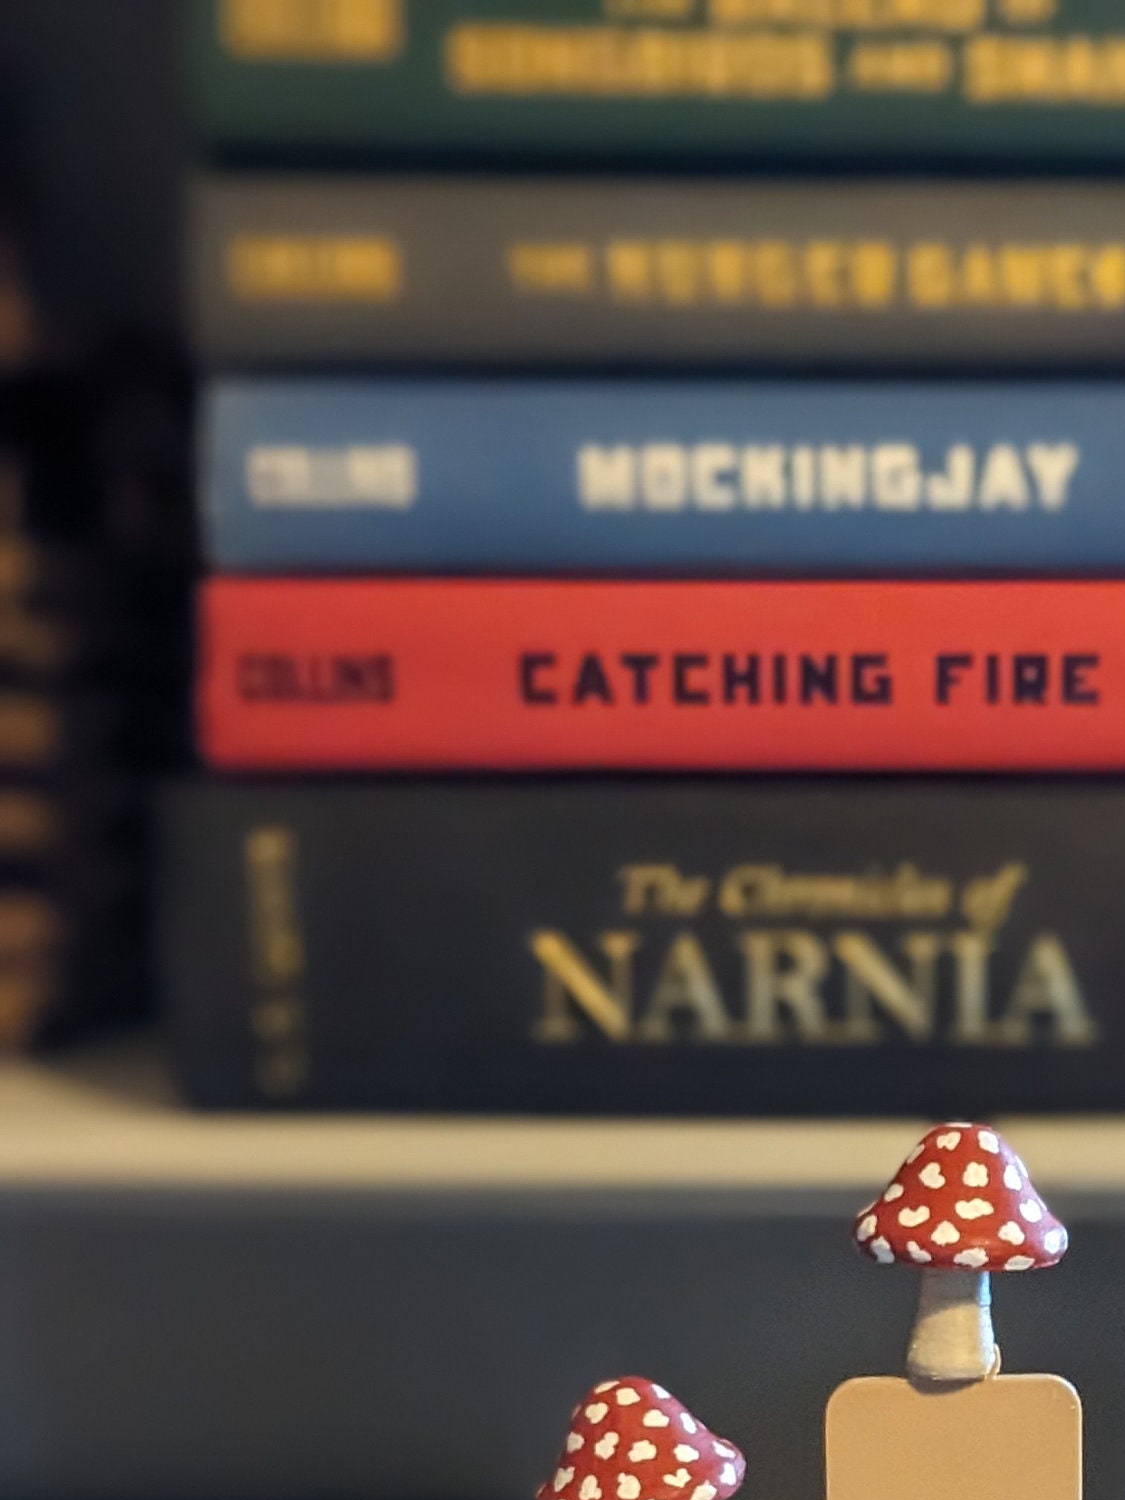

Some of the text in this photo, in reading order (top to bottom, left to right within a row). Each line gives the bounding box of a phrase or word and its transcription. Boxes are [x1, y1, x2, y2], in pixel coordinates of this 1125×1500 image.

[577, 443, 1078, 511] MOCKINGJAY
[519, 652, 1101, 706] CATCHING FIRE
[620, 863, 708, 916] The
[960, 861, 1027, 930] of
[530, 930, 1094, 1044] NARNIA
